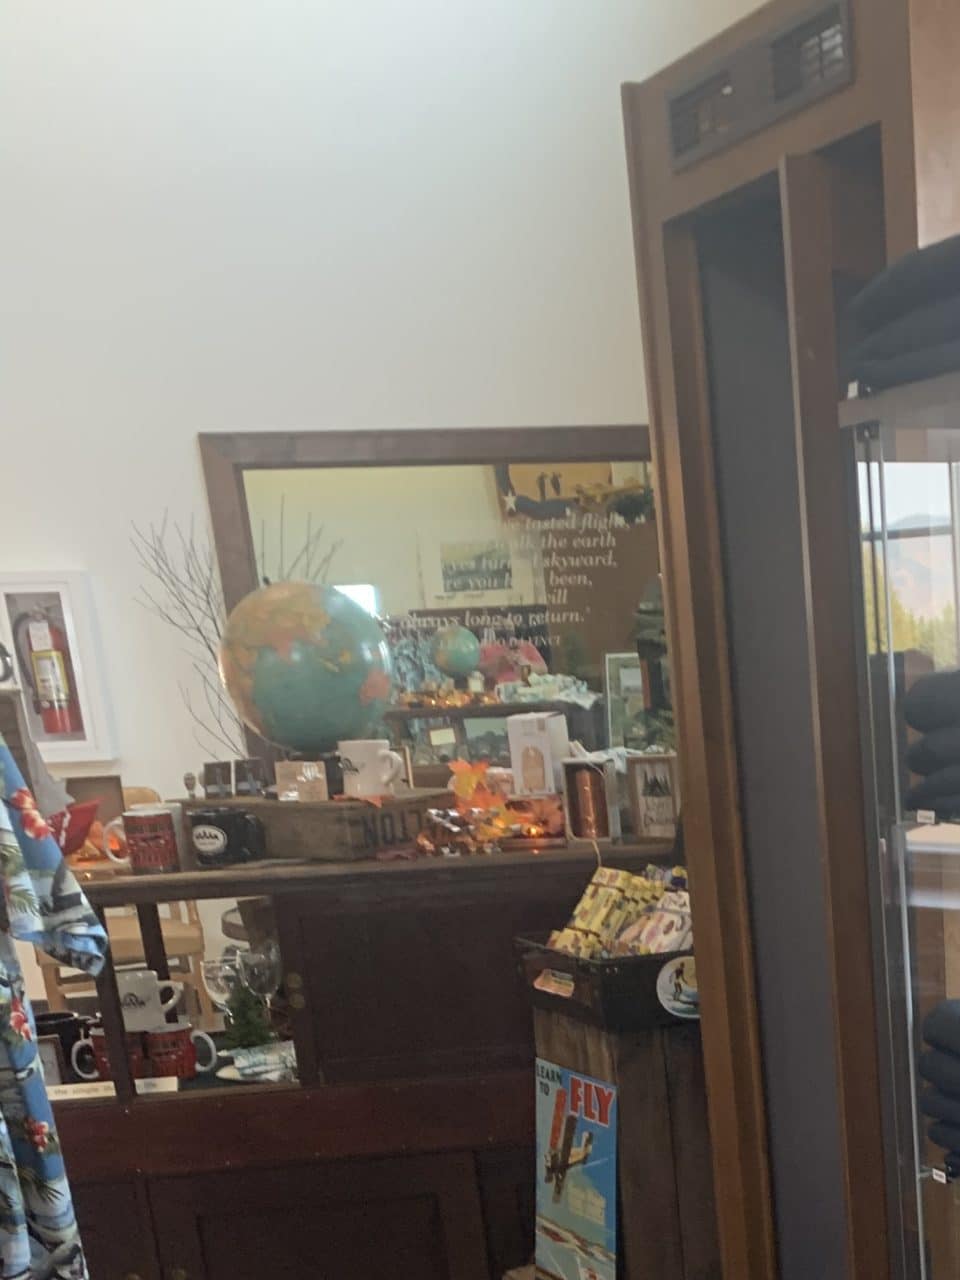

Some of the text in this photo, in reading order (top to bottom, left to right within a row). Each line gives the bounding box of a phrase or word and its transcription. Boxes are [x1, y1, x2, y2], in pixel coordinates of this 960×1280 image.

[541, 531, 568, 548] the
[571, 530, 617, 548] earth
[543, 550, 618, 573] skyward,
[550, 570, 593, 587] been,
[536, 1064, 562, 1084] LEARN
[540, 1081, 550, 1096] TO
[569, 1074, 616, 1128] FLY
